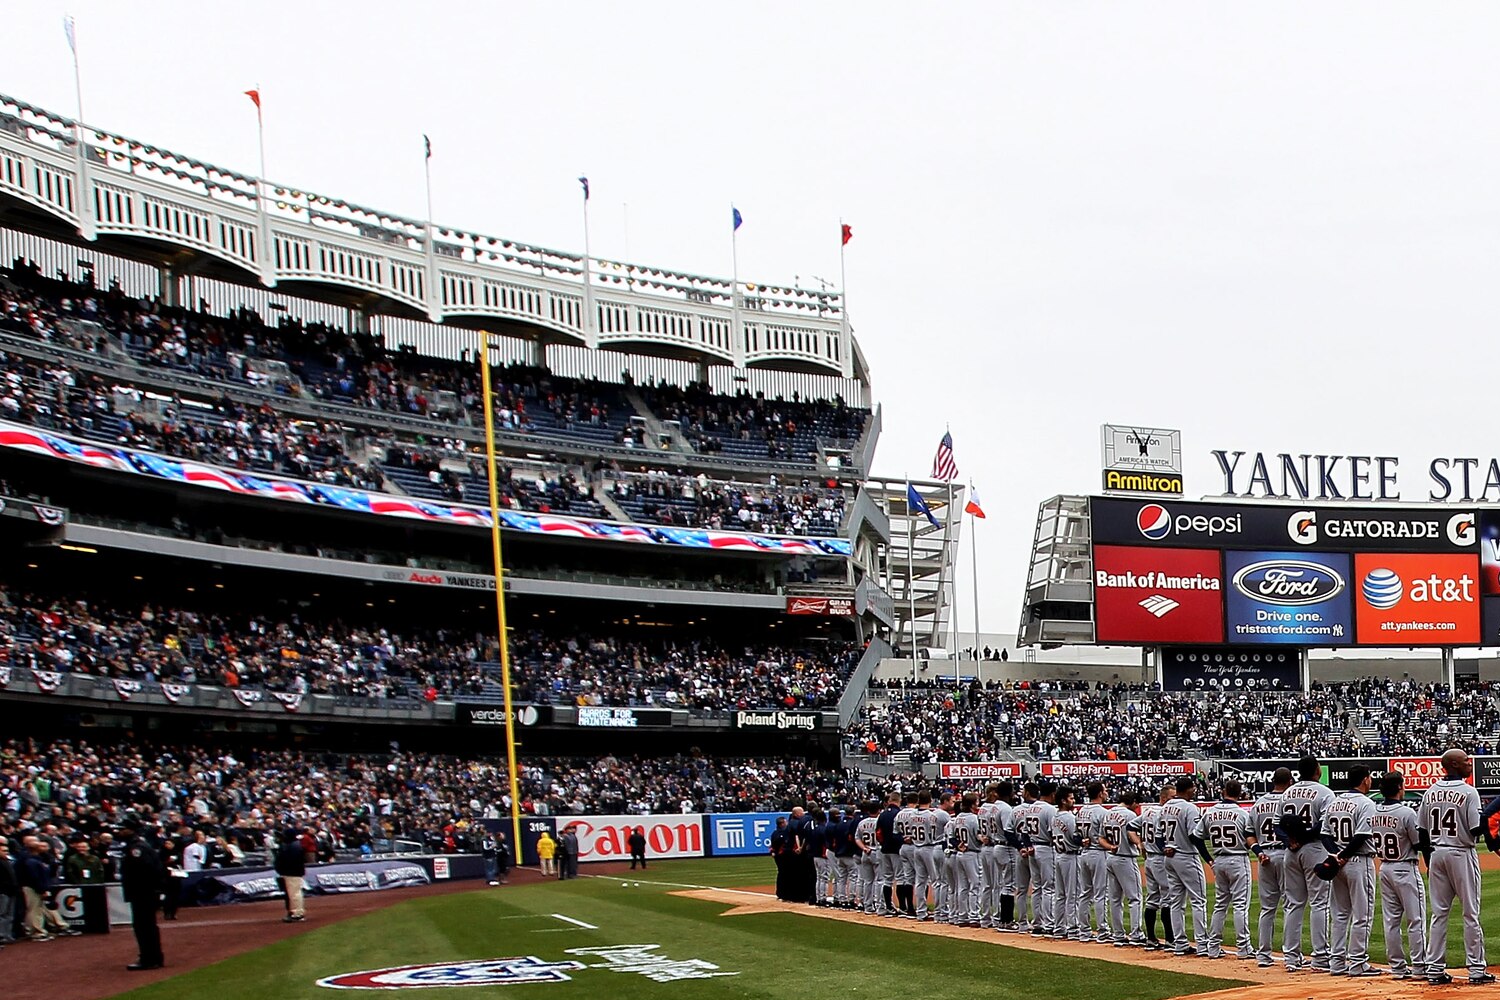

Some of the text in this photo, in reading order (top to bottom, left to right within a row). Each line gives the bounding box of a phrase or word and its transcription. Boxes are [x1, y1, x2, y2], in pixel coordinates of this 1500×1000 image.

[1118, 456, 1170, 466] AMERICA'S WATCH
[1107, 471, 1182, 493] Armitron
[1210, 449, 1400, 501] YANKEE
[1175, 513, 1243, 536] pepsi
[1324, 520, 1439, 539] GATORADE
[408, 571, 443, 584] Audi
[446, 575, 486, 588] YANKEES
[1096, 570, 1220, 591] Bank of America
[1257, 568, 1319, 596] Ford
[1409, 572, 1474, 603] at&t
[1256, 610, 1323, 623] Drive one.
[1235, 624, 1331, 636] tristateford.com
[1380, 620, 1456, 633] att.yankees.com
[1203, 664, 1219, 673] New
[1218, 664, 1234, 676] York
[614, 709, 632, 718] FOR
[737, 711, 816, 730] Poland Spring
[579, 718, 638, 727] MAINTENANCE
[962, 766, 1012, 776] State Farm
[1063, 764, 1111, 775] State Farm
[1139, 763, 1184, 774] State Farm
[1393, 761, 1446, 777] SPOR
[1426, 790, 1467, 807] JACKSON
[1208, 811, 1239, 822] RABURN
[1430, 807, 1458, 838] 14
[911, 826, 926, 841] 36
[1025, 817, 1040, 835] 53
[1076, 822, 1091, 840] 57
[1141, 821, 1155, 844] 15
[1329, 816, 1353, 843] 30
[561, 820, 701, 858] Canon
[1209, 825, 1238, 848] 25
